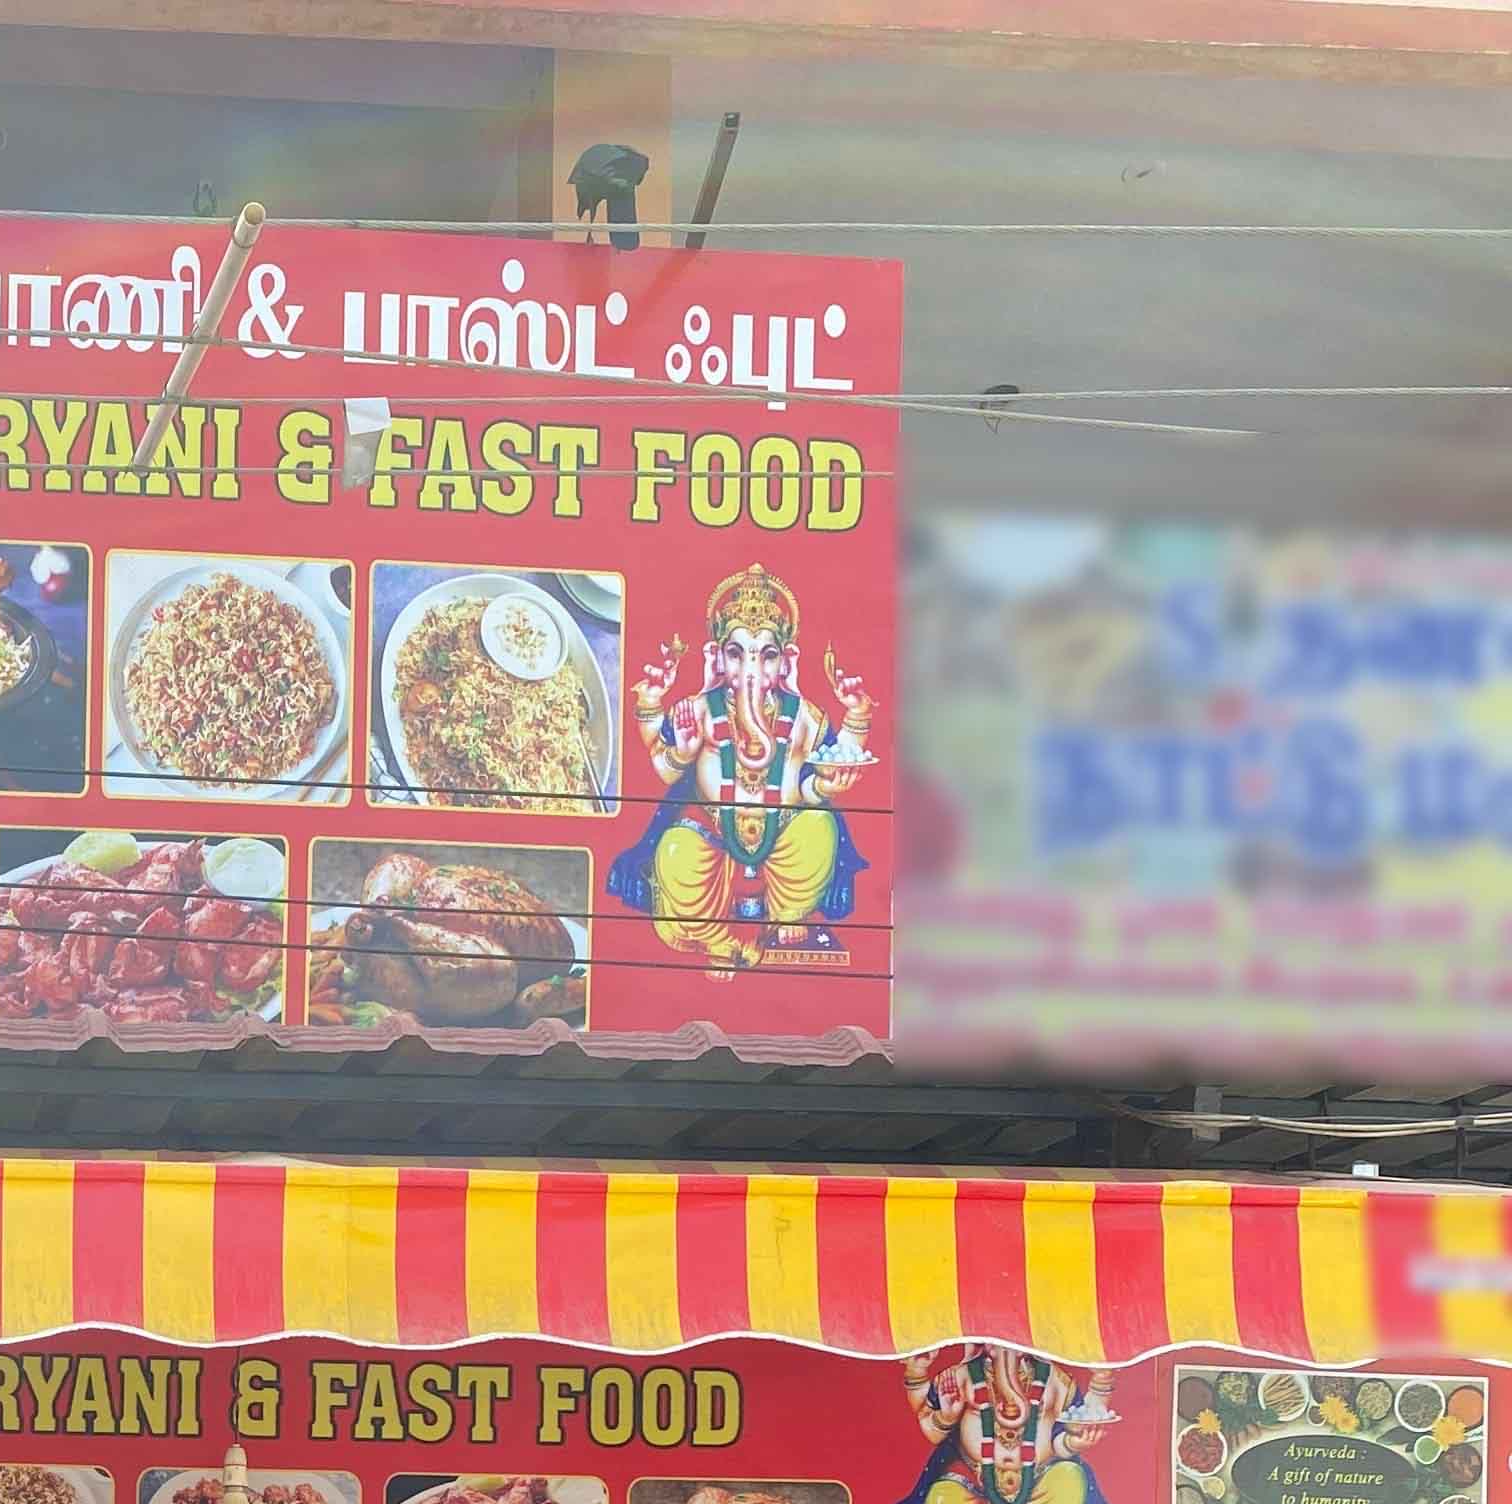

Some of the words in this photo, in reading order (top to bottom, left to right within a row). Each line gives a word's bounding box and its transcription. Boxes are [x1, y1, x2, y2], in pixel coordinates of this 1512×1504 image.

[237, 263, 305, 359] &
[343, 259, 635, 378] பாஸ்ட்
[664, 304, 854, 410] ஃபுட்
[277, 410, 333, 505] &
[368, 416, 599, 518] FAST
[632, 430, 864, 533] FOOD
[236, 1358, 281, 1438] &
[309, 1361, 513, 1444] FAST
[535, 1366, 742, 1447] FOOD
[1267, 1467, 1279, 1481] A
[1284, 1466, 1311, 1485] gift
[1315, 1468, 1333, 1486] of
[1335, 1471, 1384, 1485] nature
[1284, 1443, 1356, 1460] Ayurveda
